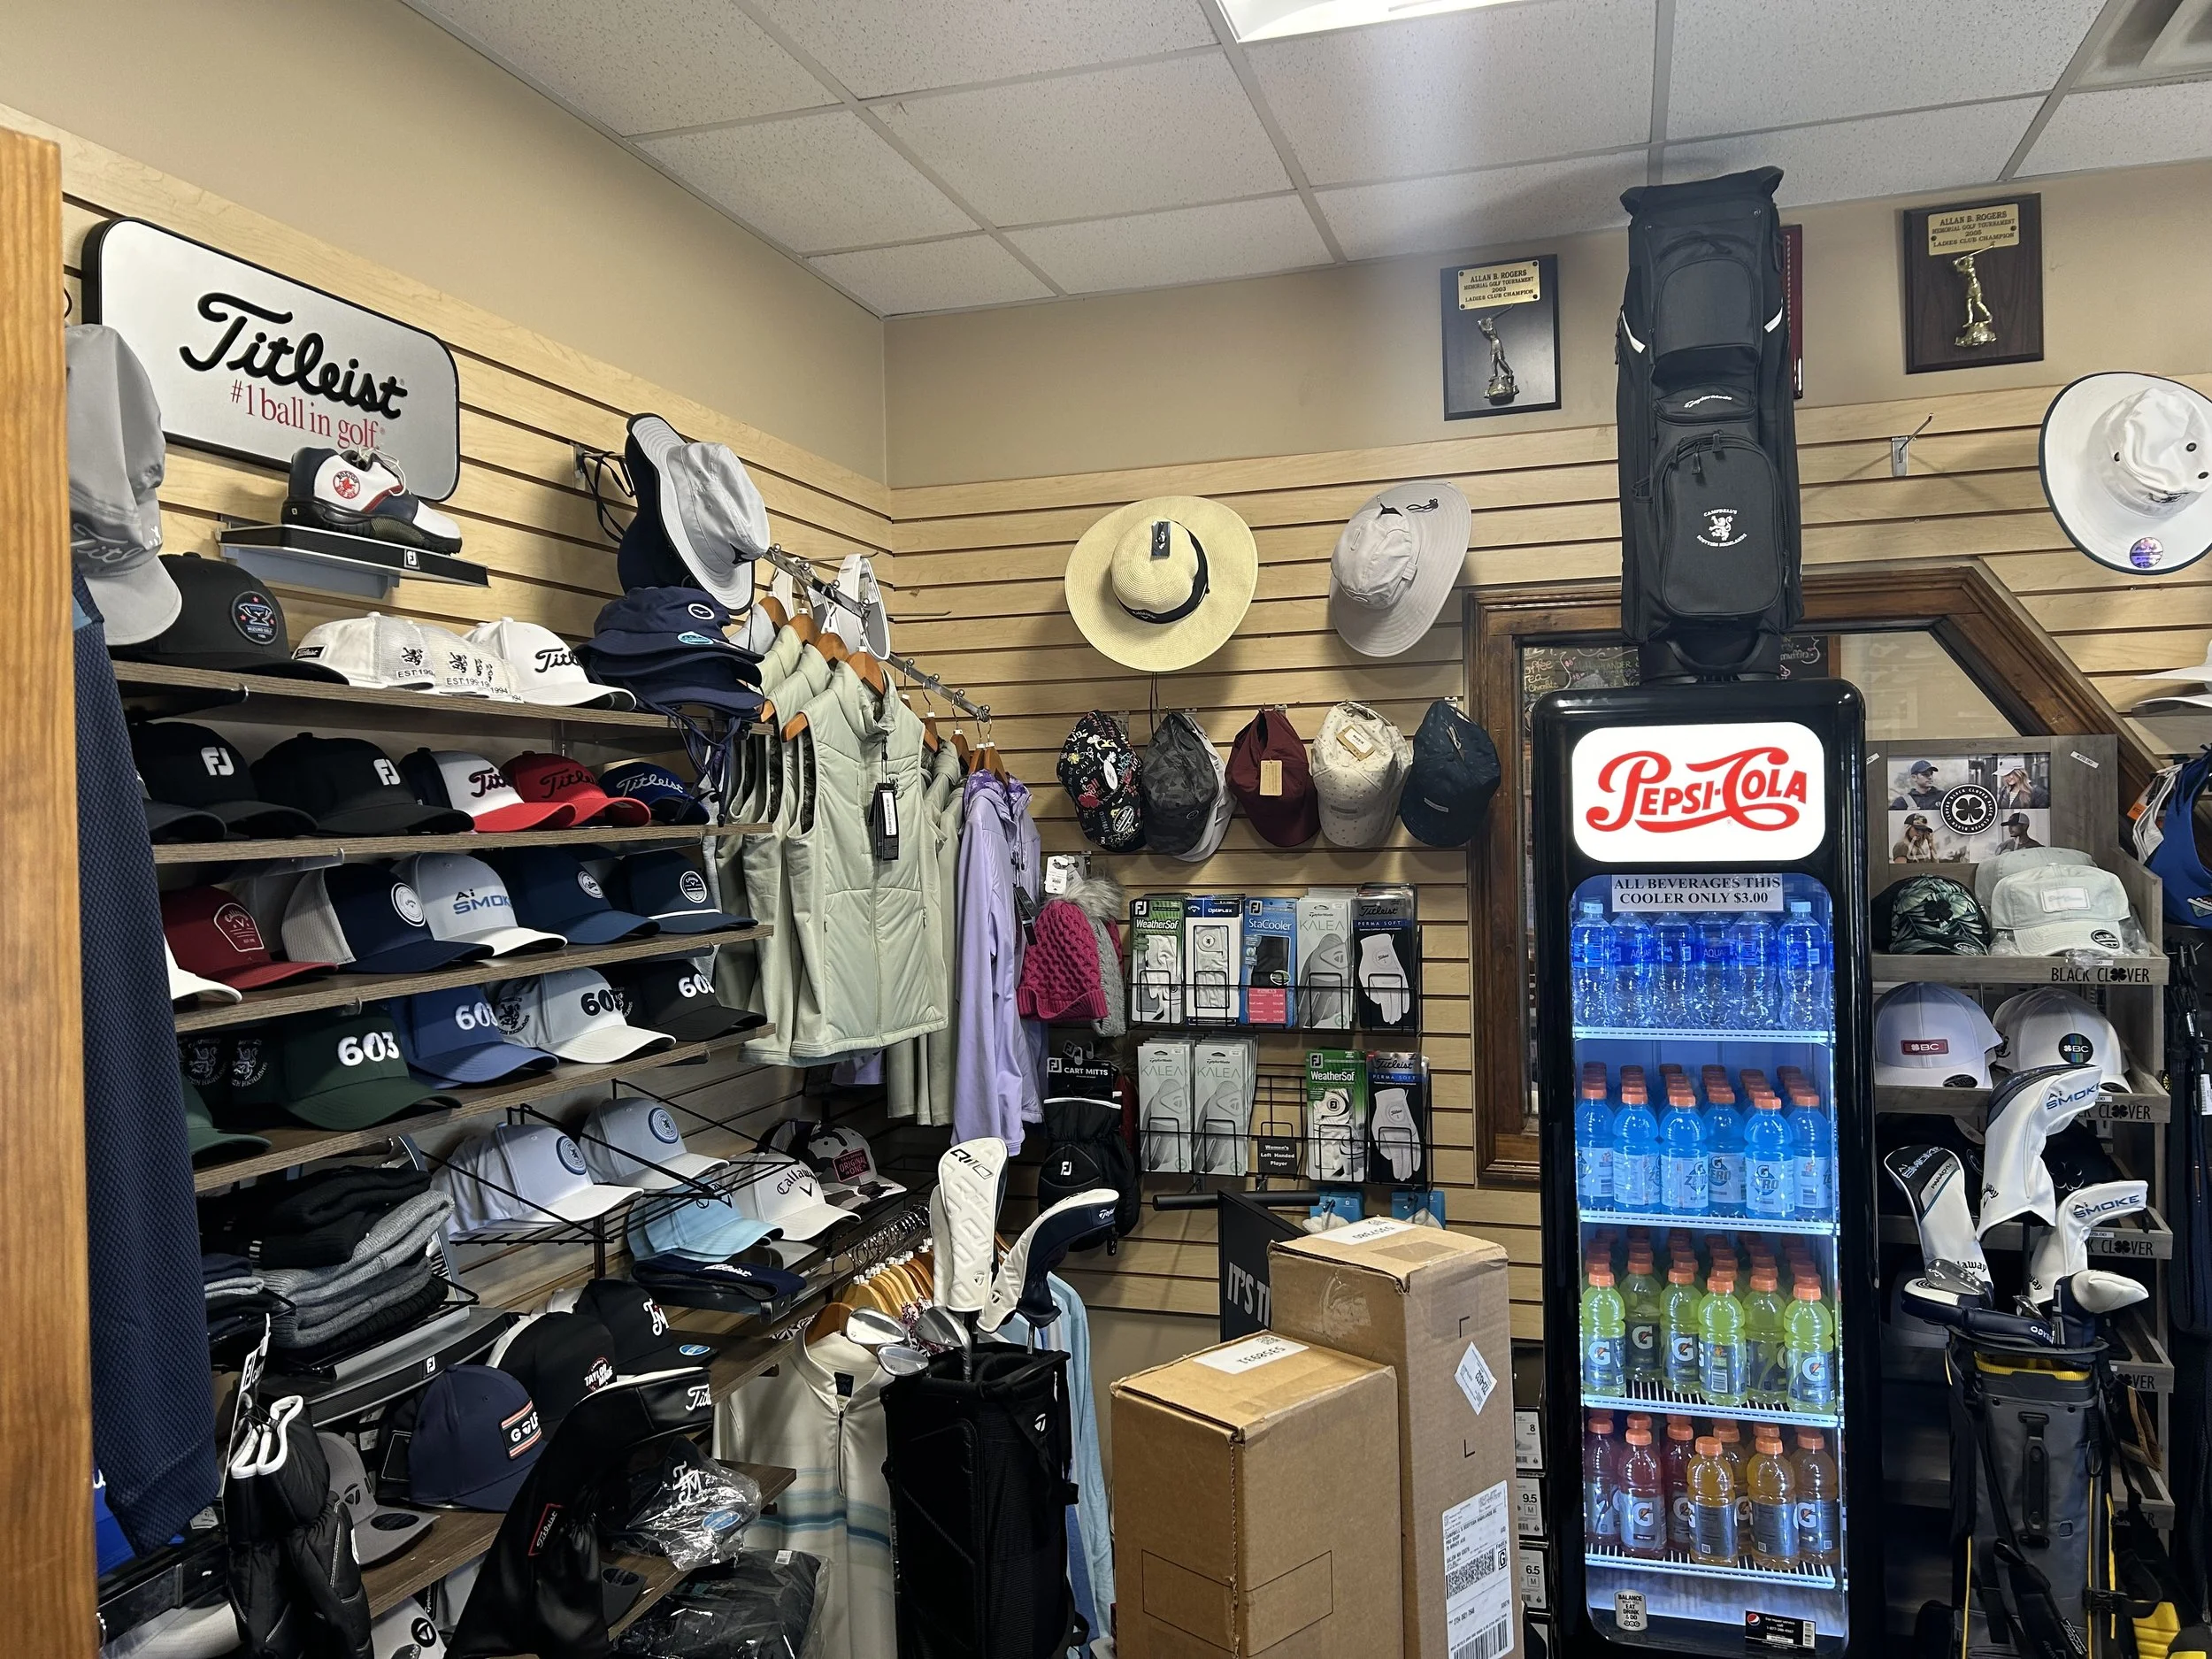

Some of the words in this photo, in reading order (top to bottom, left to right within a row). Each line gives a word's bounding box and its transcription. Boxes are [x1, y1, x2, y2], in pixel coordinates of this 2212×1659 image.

[1939, 216, 1964, 227] ALLAN
[1976, 211, 2008, 221] ROGERS
[1978, 218, 2016, 228] TOURNAMENT
[1932, 239, 1958, 248] LADIES
[1978, 232, 2015, 242] CHAMPION
[1470, 273, 1492, 283] ALLAN
[1501, 269, 1527, 279] ROGERS
[1502, 276, 1534, 285] TOURNAMENT
[1503, 288, 1534, 297] CHAMPION
[180, 292, 408, 419] Titleist
[230, 379, 256, 417] #1
[262, 386, 306, 431] ball
[310, 402, 332, 438] in
[337, 419, 381, 450] golf
[201, 747, 234, 776] FJ
[373, 759, 401, 786] FJ
[617, 773, 684, 796] Titleist
[1614, 878, 1644, 889] ALL
[1647, 877, 1740, 890] BEVERAGES
[1743, 876, 1781, 888] THIS
[455, 888, 475, 902] Ai
[1619, 893, 1685, 904] COOLER
[1687, 892, 1731, 904] ONLY
[1733, 891, 1769, 904] $3.00
[1134, 901, 1148, 916] FJ
[1250, 902, 1261, 914] FJ
[1358, 903, 1399, 917] Titleist
[1135, 918, 1179, 930] WeatherSof
[1248, 918, 1292, 931] StaCooler
[1299, 919, 1346, 932] KALEA
[2051, 967, 2090, 982] BLACK
[1311, 1055, 1322, 1067] FJ
[1372, 1057, 1414, 1070] Titleist
[1141, 1065, 1184, 1077] KALEA
[1197, 1066, 1241, 1079] KALEA
[1310, 1071, 1356, 1082] WeatherSof
[2046, 1081, 2101, 1110] SMOKE
[2047, 1090, 2062, 1101] Ai
[839, 1156, 867, 1173] ORIGINAL
[849, 1165, 864, 1175] ONE
[1060, 1161, 1072, 1176] FJ
[1709, 1170, 1732, 1181] ERO
[2072, 1194, 2139, 1219] SMOKE
[426, 1356, 436, 1374] FJ
[584, 1363, 607, 1386] TAYLOR
[1529, 1424, 1536, 1432] 8
[1522, 1493, 1538, 1504] 9.5
[1525, 1564, 1540, 1575] 6.5
